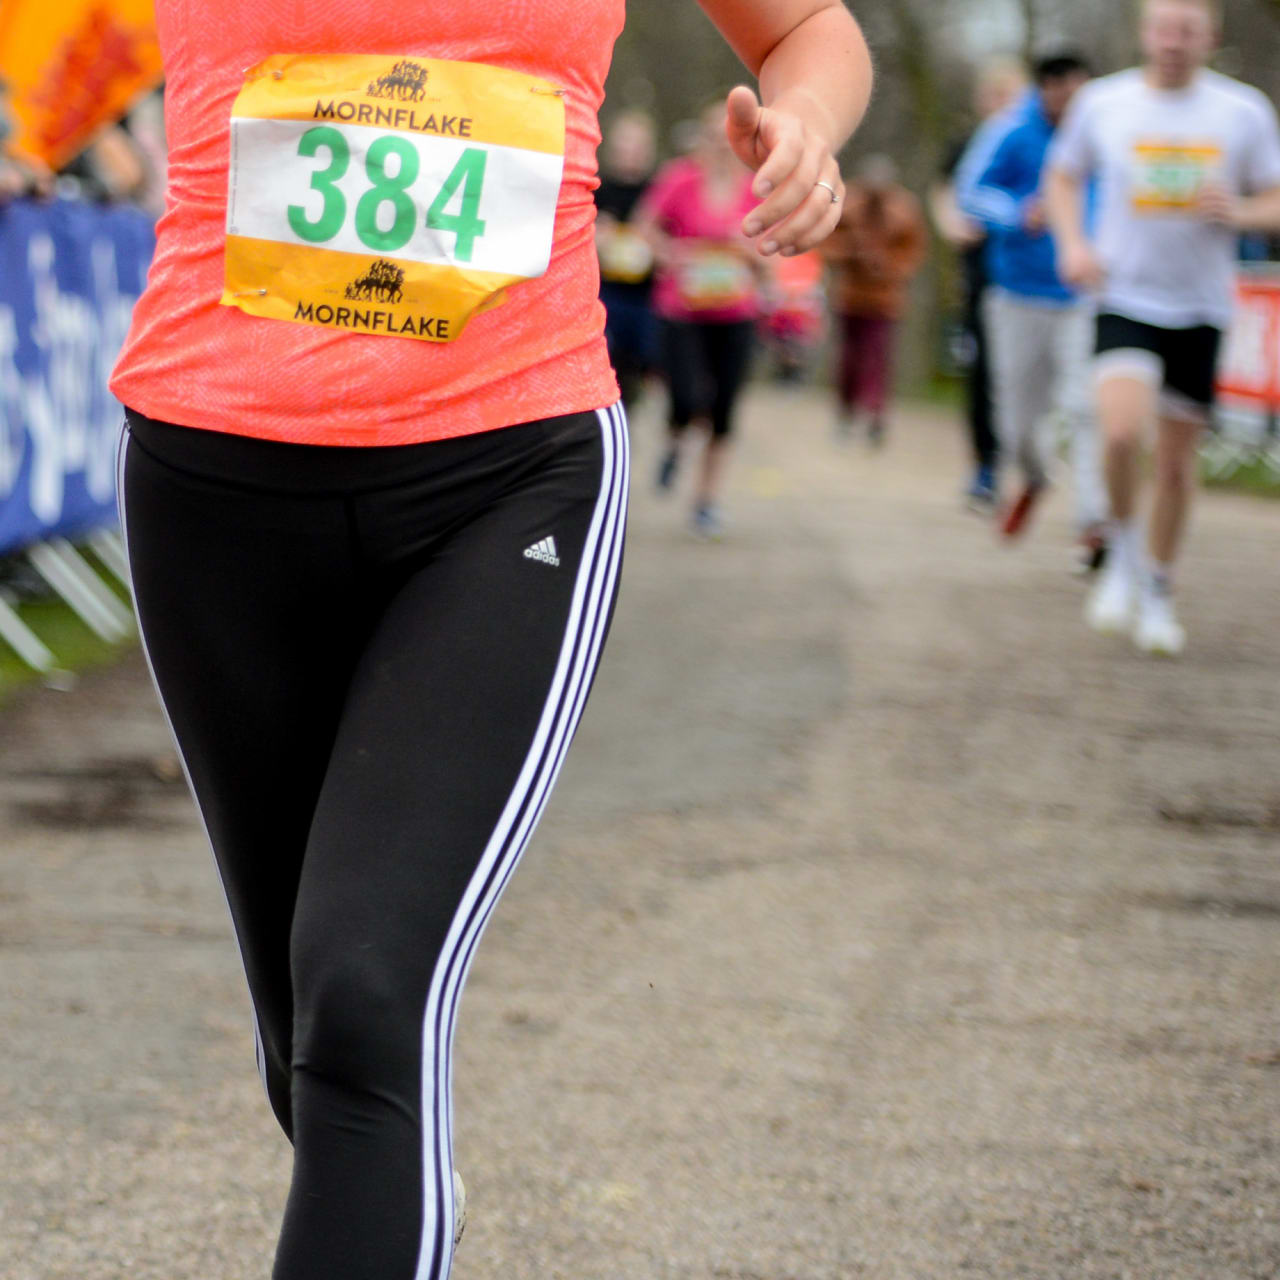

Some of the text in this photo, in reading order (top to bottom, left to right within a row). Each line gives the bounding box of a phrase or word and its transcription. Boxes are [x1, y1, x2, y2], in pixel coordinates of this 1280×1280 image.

[313, 98, 473, 138] MORNFLAKE
[287, 125, 489, 263] 384
[293, 300, 451, 340] MORNFLAKE
[523, 548, 560, 568] adidas
